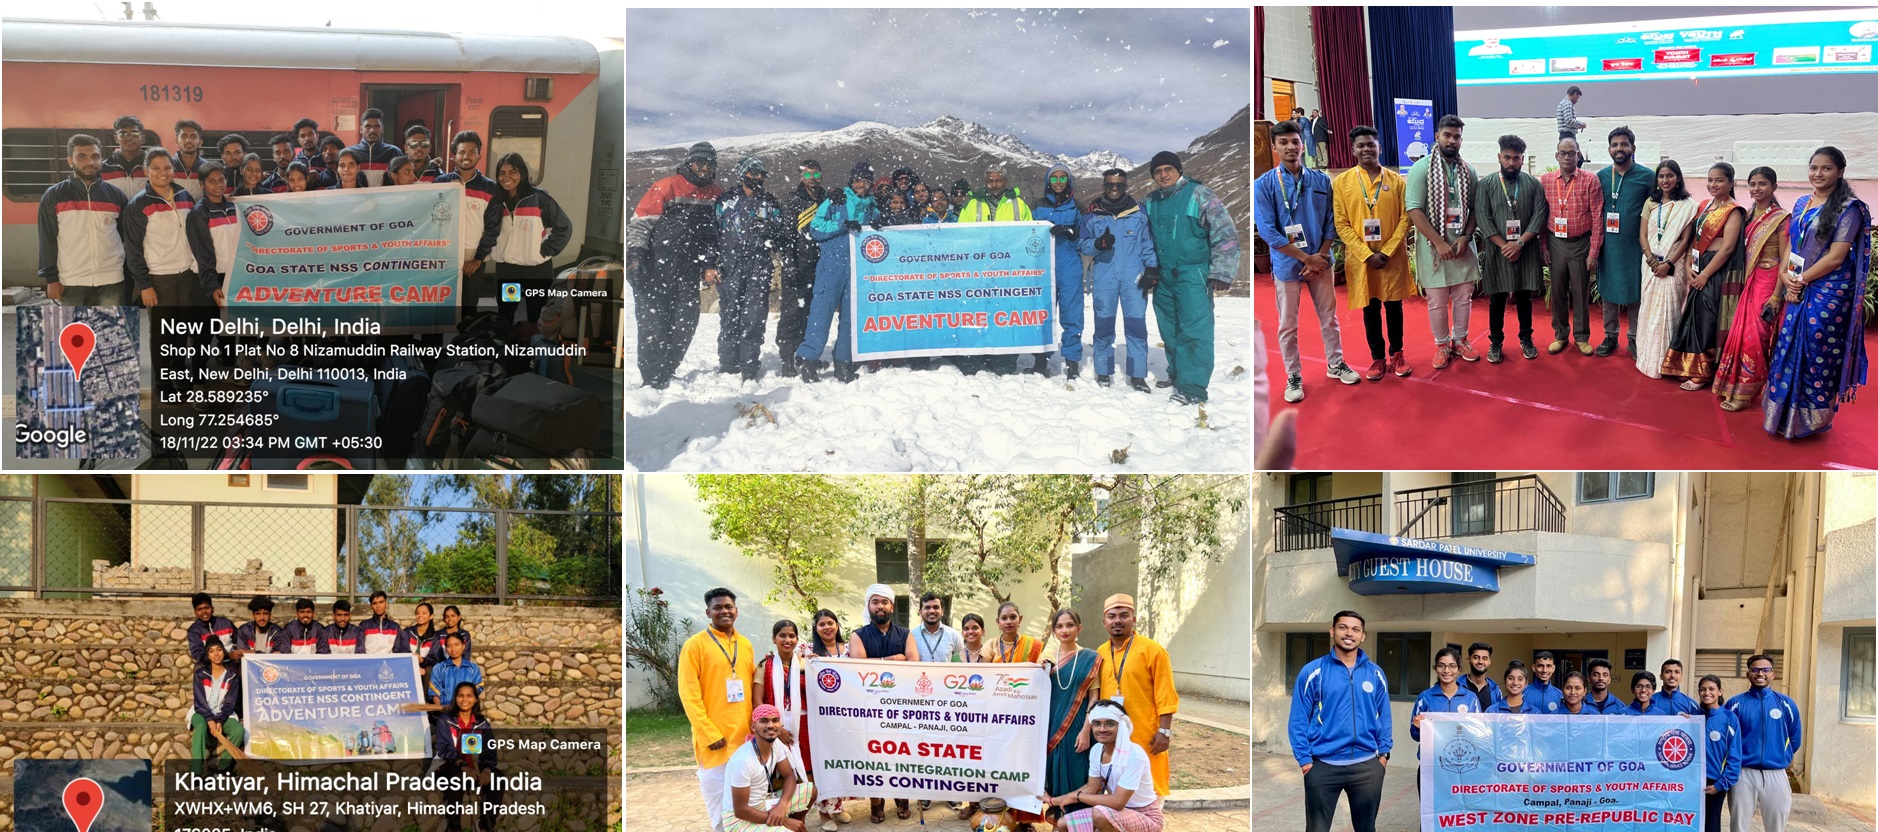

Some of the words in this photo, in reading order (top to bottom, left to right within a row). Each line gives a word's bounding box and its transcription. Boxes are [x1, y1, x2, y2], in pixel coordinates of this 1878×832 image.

[140, 84, 203, 103] 181319
[284, 223, 366, 236] GOVERNMENT
[369, 222, 385, 231] OF
[388, 220, 415, 230] GOA
[251, 245, 314, 256] DIRECTORATE
[316, 245, 329, 253] OF
[331, 243, 368, 252] SPORTS
[382, 240, 412, 249] YOUTH
[899, 253, 970, 263] GOVERNMENT
[973, 252, 986, 260] OF
[989, 251, 1011, 260] GOA
[245, 263, 276, 274] GOA
[280, 264, 326, 274] STATE
[330, 263, 359, 273] NSS
[363, 260, 447, 273] CONTINGENT
[869, 273, 925, 282] DIRECTORATE
[939, 271, 971, 279] SPORTS
[982, 270, 1010, 278] YOUTH
[234, 286, 383, 304] ADVENTURE
[389, 285, 452, 304] CAMP
[868, 292, 894, 302] GOA
[897, 291, 934, 301] STATE
[938, 289, 962, 299] NSS
[965, 287, 1042, 298] CONTINGENT
[863, 312, 988, 332] ADVENTURE
[994, 310, 1048, 327] CAMP
[1401, 538, 1437, 551] SARDAR
[1439, 543, 1462, 555] PATEL
[1464, 547, 1507, 560] UNIVERSITY
[1363, 557, 1410, 578] GUEST
[1416, 557, 1473, 583] HOUSE
[256, 687, 306, 695] DIRECTORATE
[317, 685, 346, 693] SPORTS
[379, 682, 409, 690] AFFAIRS
[254, 697, 280, 706] GOA
[281, 696, 315, 705] STATE
[317, 694, 339, 703] NSS
[340, 691, 412, 703] CONTINGENT
[880, 697, 935, 707] GOVERNMENT
[950, 700, 968, 708] GOA
[258, 705, 362, 723] ADVENTURE
[819, 706, 884, 719] DIRECTORATE
[886, 709, 900, 719] OF
[902, 710, 941, 721] SPORTS
[944, 711, 952, 722] &
[954, 712, 989, 723] YOUTH
[991, 713, 1036, 726] AFFAIRS
[880, 722, 912, 730] CAMPAL
[918, 723, 948, 732] PANAJI,
[867, 739, 912, 756] GOA
[917, 742, 983, 761] STATE
[824, 759, 892, 772] NATIONAL
[895, 763, 986, 779] INTEGRATION
[990, 770, 1031, 783] CAMP
[1496, 761, 1593, 773] GOVERNMENT
[1597, 761, 1615, 772] OF
[1618, 761, 1646, 772] GOA
[853, 774, 884, 787] NSS
[889, 776, 999, 793] CONTINGENT
[1451, 784, 1529, 794] DIRECTORATE
[1532, 785, 1547, 793] OF
[1550, 785, 1592, 793] SPORTS
[1595, 783, 1602, 792] &
[1605, 782, 1639, 791] YOUTH
[1642, 782, 1684, 792] AFFAIRS
[1523, 798, 1562, 808] Campal,
[1564, 798, 1592, 807] Panaji
[1438, 812, 1488, 828] WEST
[1493, 812, 1539, 825] ZONE
[1544, 810, 1659, 825] PRE-REPUBLIC
[1663, 812, 1695, 826] DAY
